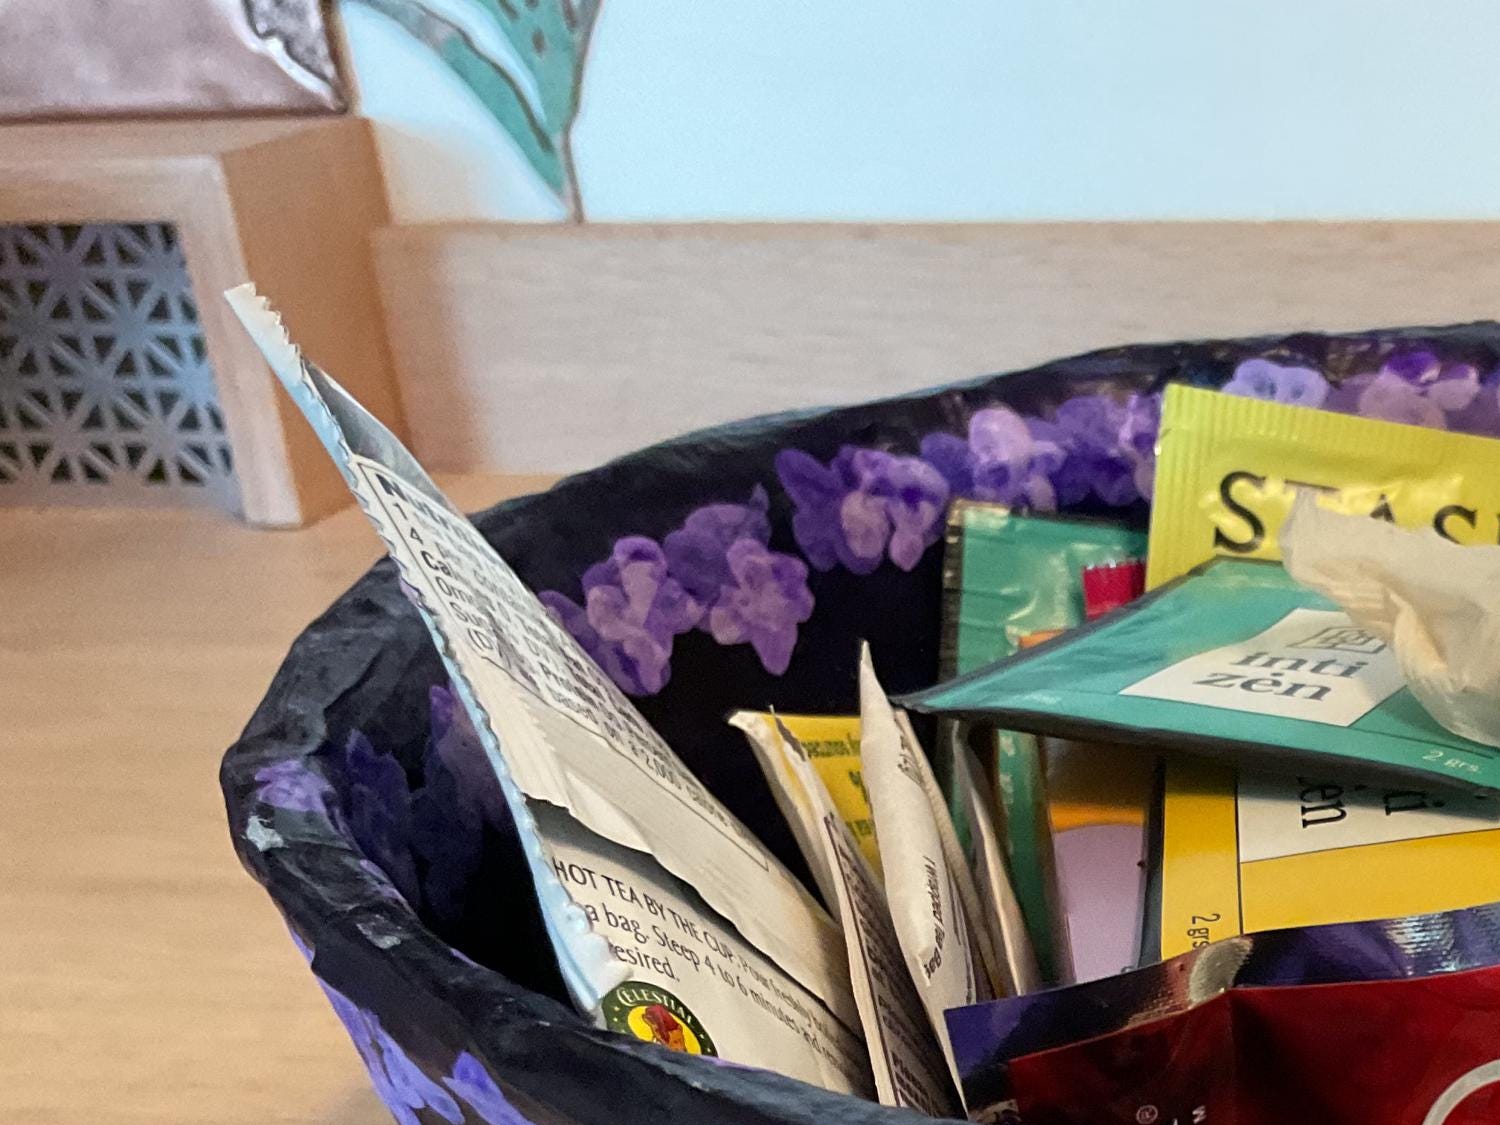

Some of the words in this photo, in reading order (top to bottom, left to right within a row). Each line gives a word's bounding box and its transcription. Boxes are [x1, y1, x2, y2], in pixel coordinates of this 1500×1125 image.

[1229, 651, 1369, 679] inti
[1421, 749, 1444, 762] 2
[552, 856, 598, 890] HOT
[601, 874, 644, 910] TEA
[643, 892, 667, 920] BY
[667, 906, 704, 944] THE
[1190, 912, 1222, 925] 2
[651, 924, 701, 973] Steep
[704, 954, 717, 976] 4
